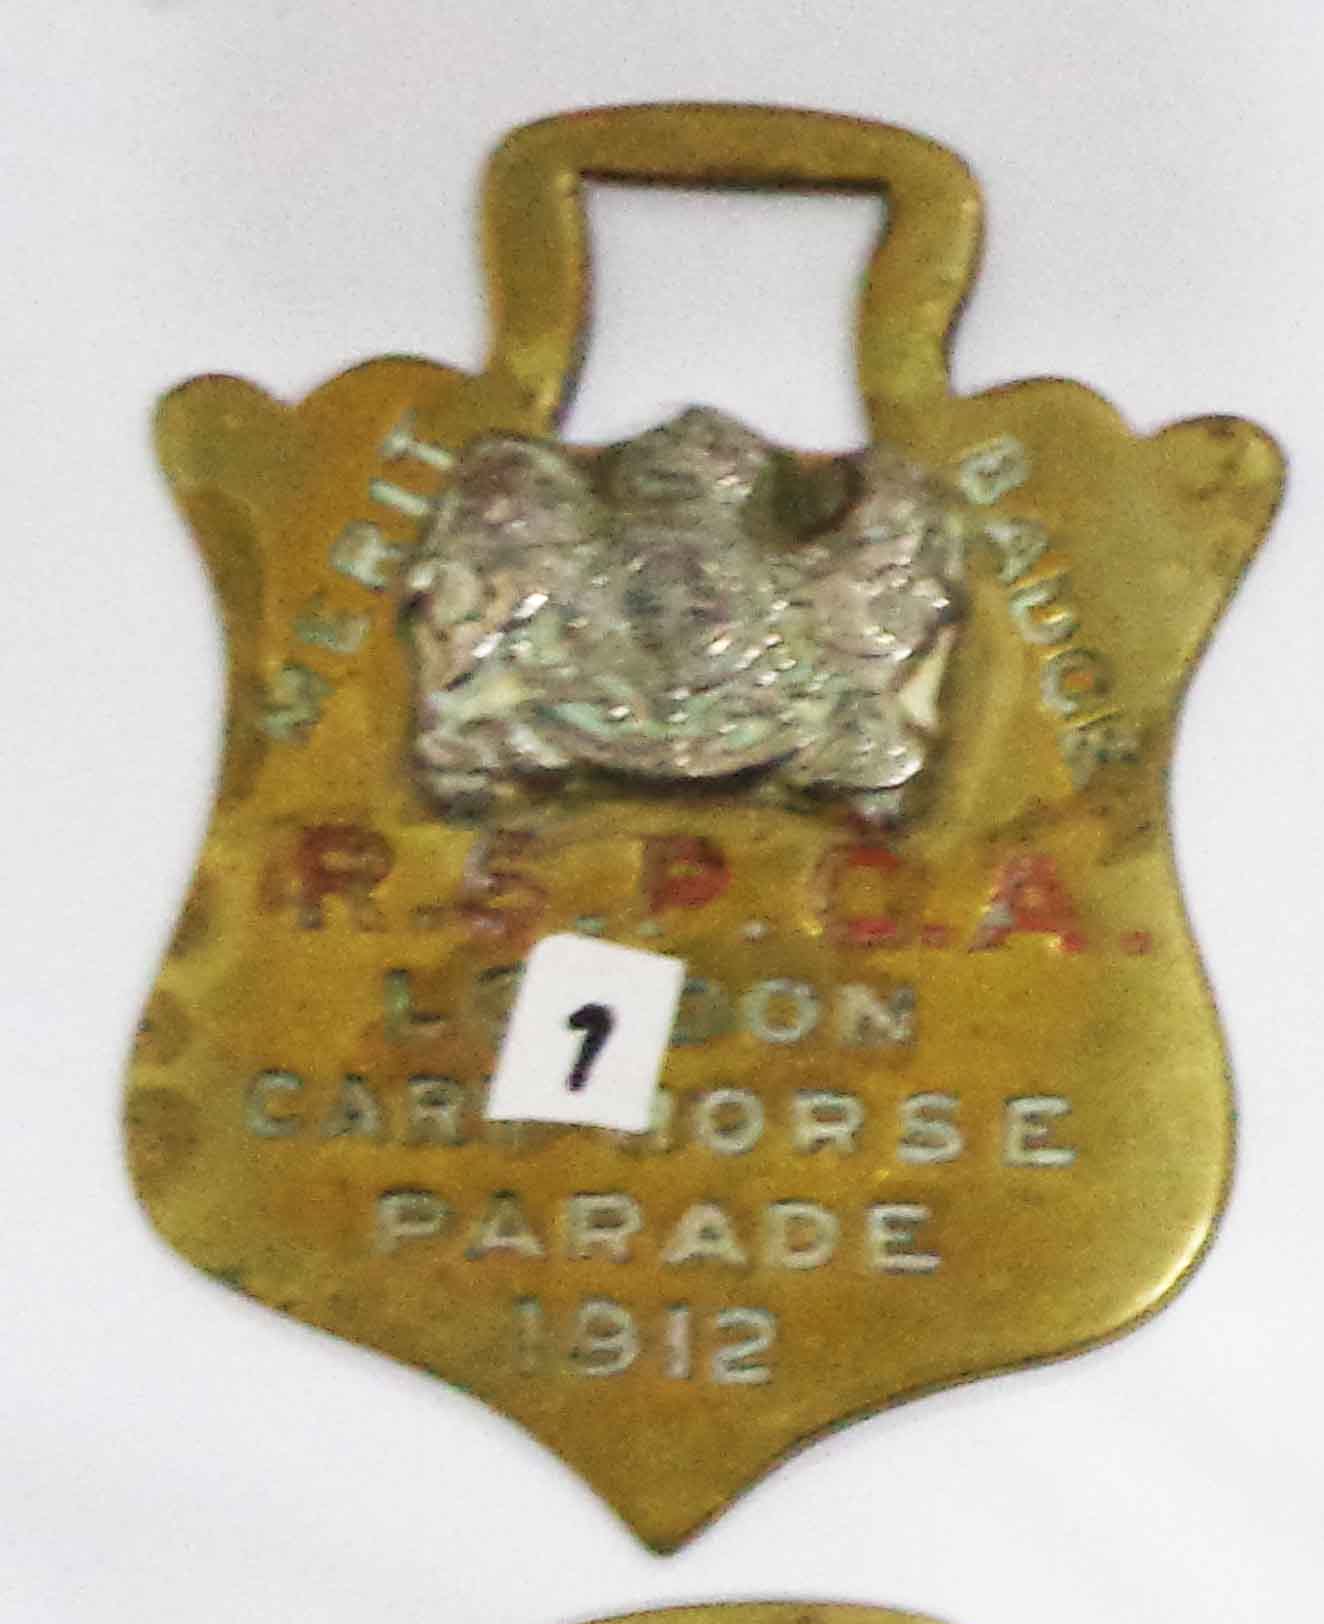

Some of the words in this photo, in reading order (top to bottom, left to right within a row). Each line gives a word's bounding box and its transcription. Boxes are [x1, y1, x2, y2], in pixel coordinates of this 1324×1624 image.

[245, 1068, 530, 1147] CAR
[372, 1188, 944, 1278] PARADE
[513, 1297, 779, 1388] 1912
